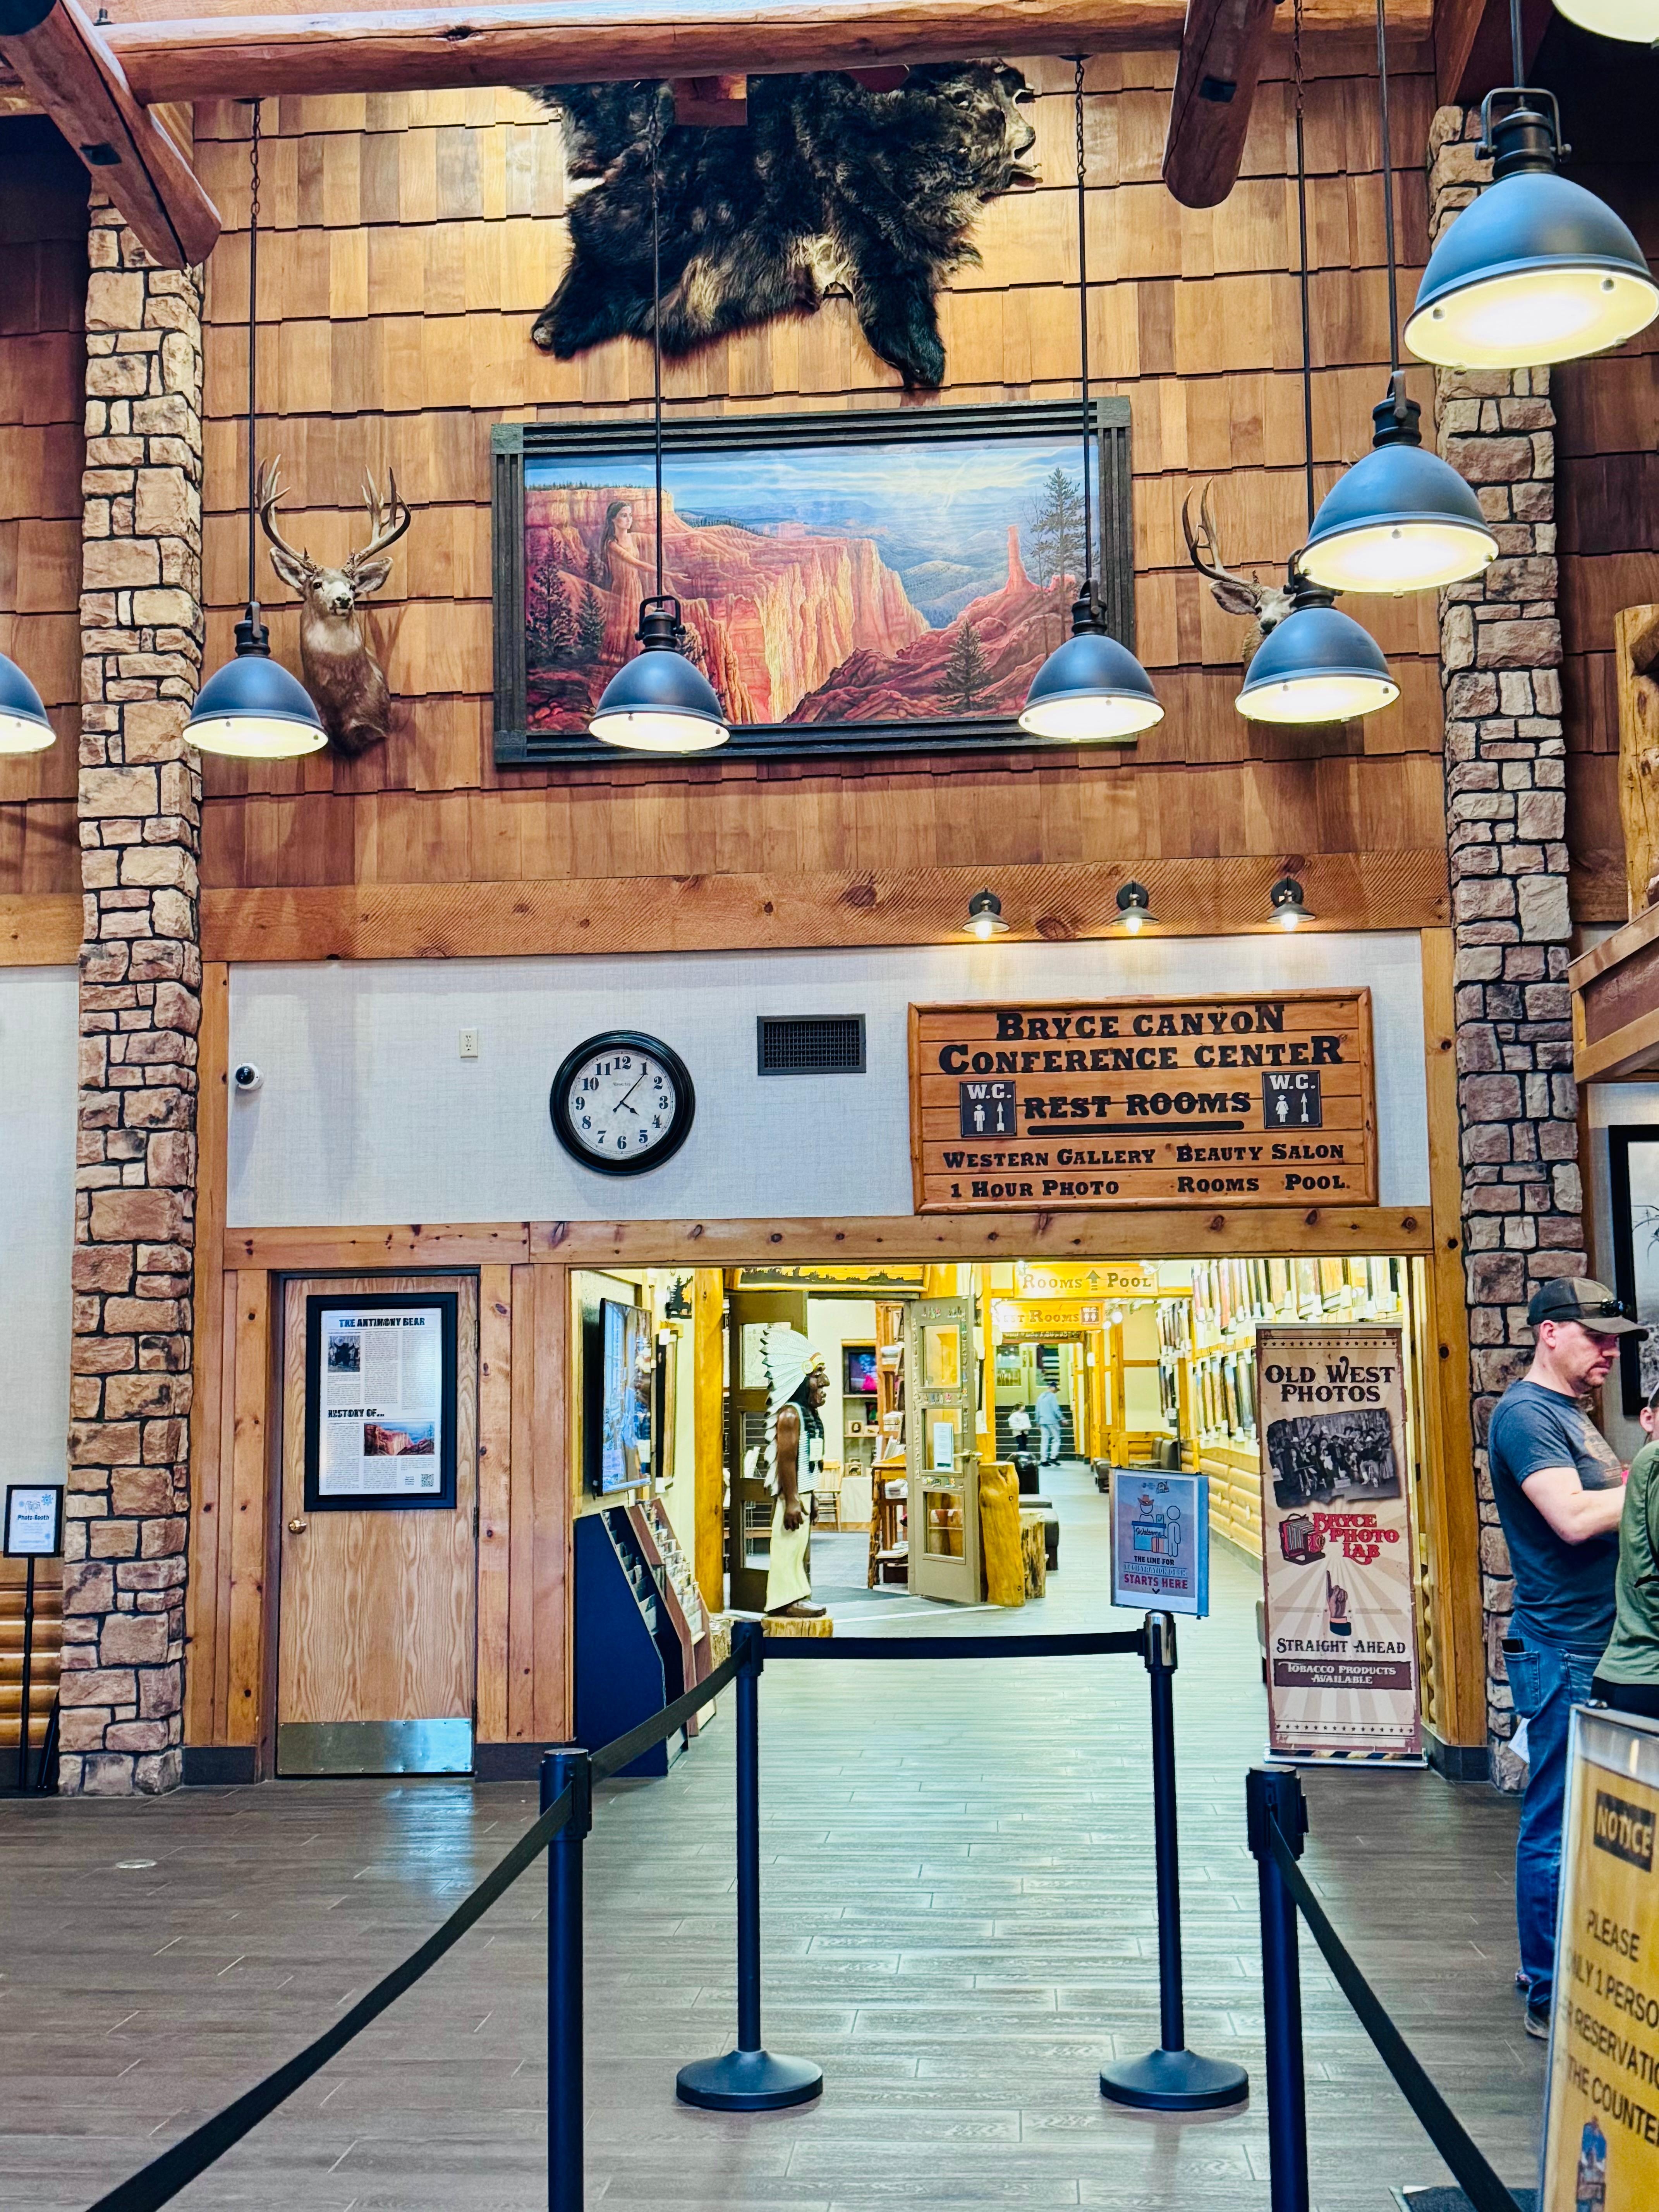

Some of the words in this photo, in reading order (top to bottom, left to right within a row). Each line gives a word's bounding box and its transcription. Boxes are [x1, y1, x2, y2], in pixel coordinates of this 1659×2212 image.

[996, 1012, 1119, 1041] BRYCE
[1133, 1005, 1285, 1036] CANYON
[939, 1044, 1178, 1075] CONFERENCE
[1194, 1035, 1343, 1068] CENTER
[595, 1062, 611, 1075] 11
[613, 1056, 631, 1070] 12
[641, 1062, 648, 1075] 1
[582, 1077, 599, 1091] 10
[654, 1076, 663, 1090] 2
[1269, 1074, 1316, 1091] W.C.
[967, 1083, 1012, 1100] W.C.
[576, 1097, 585, 1110] 9
[659, 1096, 668, 1109] 3
[1025, 1096, 1111, 1119] REST
[1126, 1092, 1251, 1116] ROOMS
[582, 1116, 591, 1129] 8
[653, 1115, 662, 1128] 4
[597, 1130, 606, 1144] 7
[617, 1136, 627, 1149] 6
[639, 1130, 648, 1143] 5
[943, 1151, 1048, 1168] WESTERN
[1057, 1148, 1156, 1166] GALLERY
[1176, 1145, 1264, 1163] BEAUTY
[1272, 1144, 1344, 1160] SALON
[951, 1183, 961, 1197] 1
[972, 1180, 1034, 1197] HOUR
[1042, 1179, 1119, 1196] PHOTO
[1178, 1175, 1259, 1193] ROOMS
[1023, 1274, 1082, 1288] ROOMS
[1107, 1273, 1151, 1288] POOL
[403, 1318, 425, 1326] BEAR
[1030, 1310, 1079, 1322] ROOMS
[1264, 1365, 1316, 1384] OLD
[1327, 1356, 1395, 1383] WEST
[1281, 1384, 1380, 1402] PHOTOS
[328, 1409, 364, 1417] HISTORY
[1312, 1512, 1377, 1533] BRYCE
[1329, 1529, 1399, 1543] PHOTO
[1343, 1542, 1380, 1565] LAB
[1125, 1574, 1158, 1586] STARTS
[1162, 1578, 1188, 1589] HERE
[1276, 1638, 1347, 1653] STRAIGHT
[1353, 1639, 1405, 1653] AHEAD
[1279, 1661, 1334, 1674] TOBACCO
[1339, 1665, 1396, 1675] PRODUCTS
[1311, 1674, 1373, 1684] AVAILABLE
[1596, 1804, 1653, 1858] NOTICE
[1587, 1908, 1640, 1963] PLEASE
[1595, 1968, 1602, 1996] 1
[1606, 1975, 1659, 2028] PERSO
[1592, 2077, 1659, 2147] COUNTE
